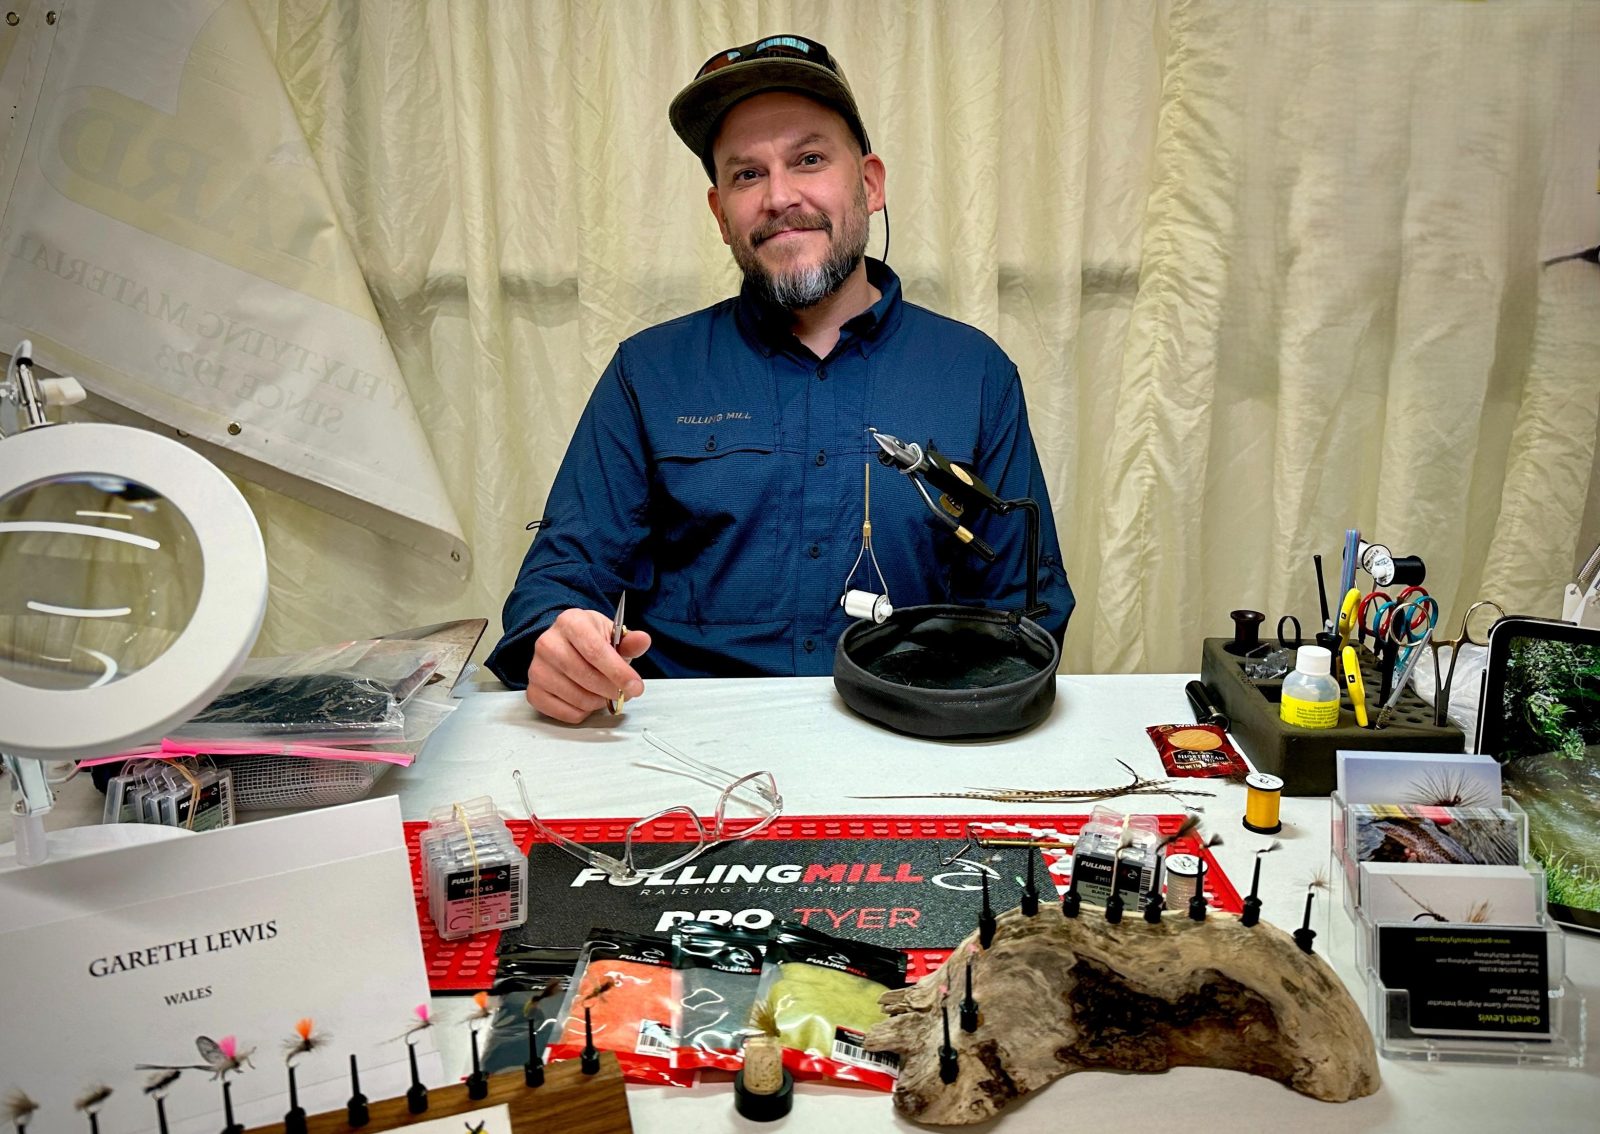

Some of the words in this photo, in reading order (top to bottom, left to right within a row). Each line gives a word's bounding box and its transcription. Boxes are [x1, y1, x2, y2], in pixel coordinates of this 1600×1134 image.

[676, 413, 723, 424] FULLING
[725, 412, 752, 420] MILL
[639, 885, 733, 897] RAISING
[746, 885, 784, 894] THE
[797, 885, 857, 894] GAME
[793, 907, 922, 930] TYER
[88, 937, 200, 978] GARETH
[204, 919, 278, 953] LEWIS
[163, 985, 213, 1007] WALES
[1457, 1000, 1483, 1009] Angling
[1477, 1013, 1505, 1023] Lewis
[1506, 1014, 1541, 1025] Gareth
